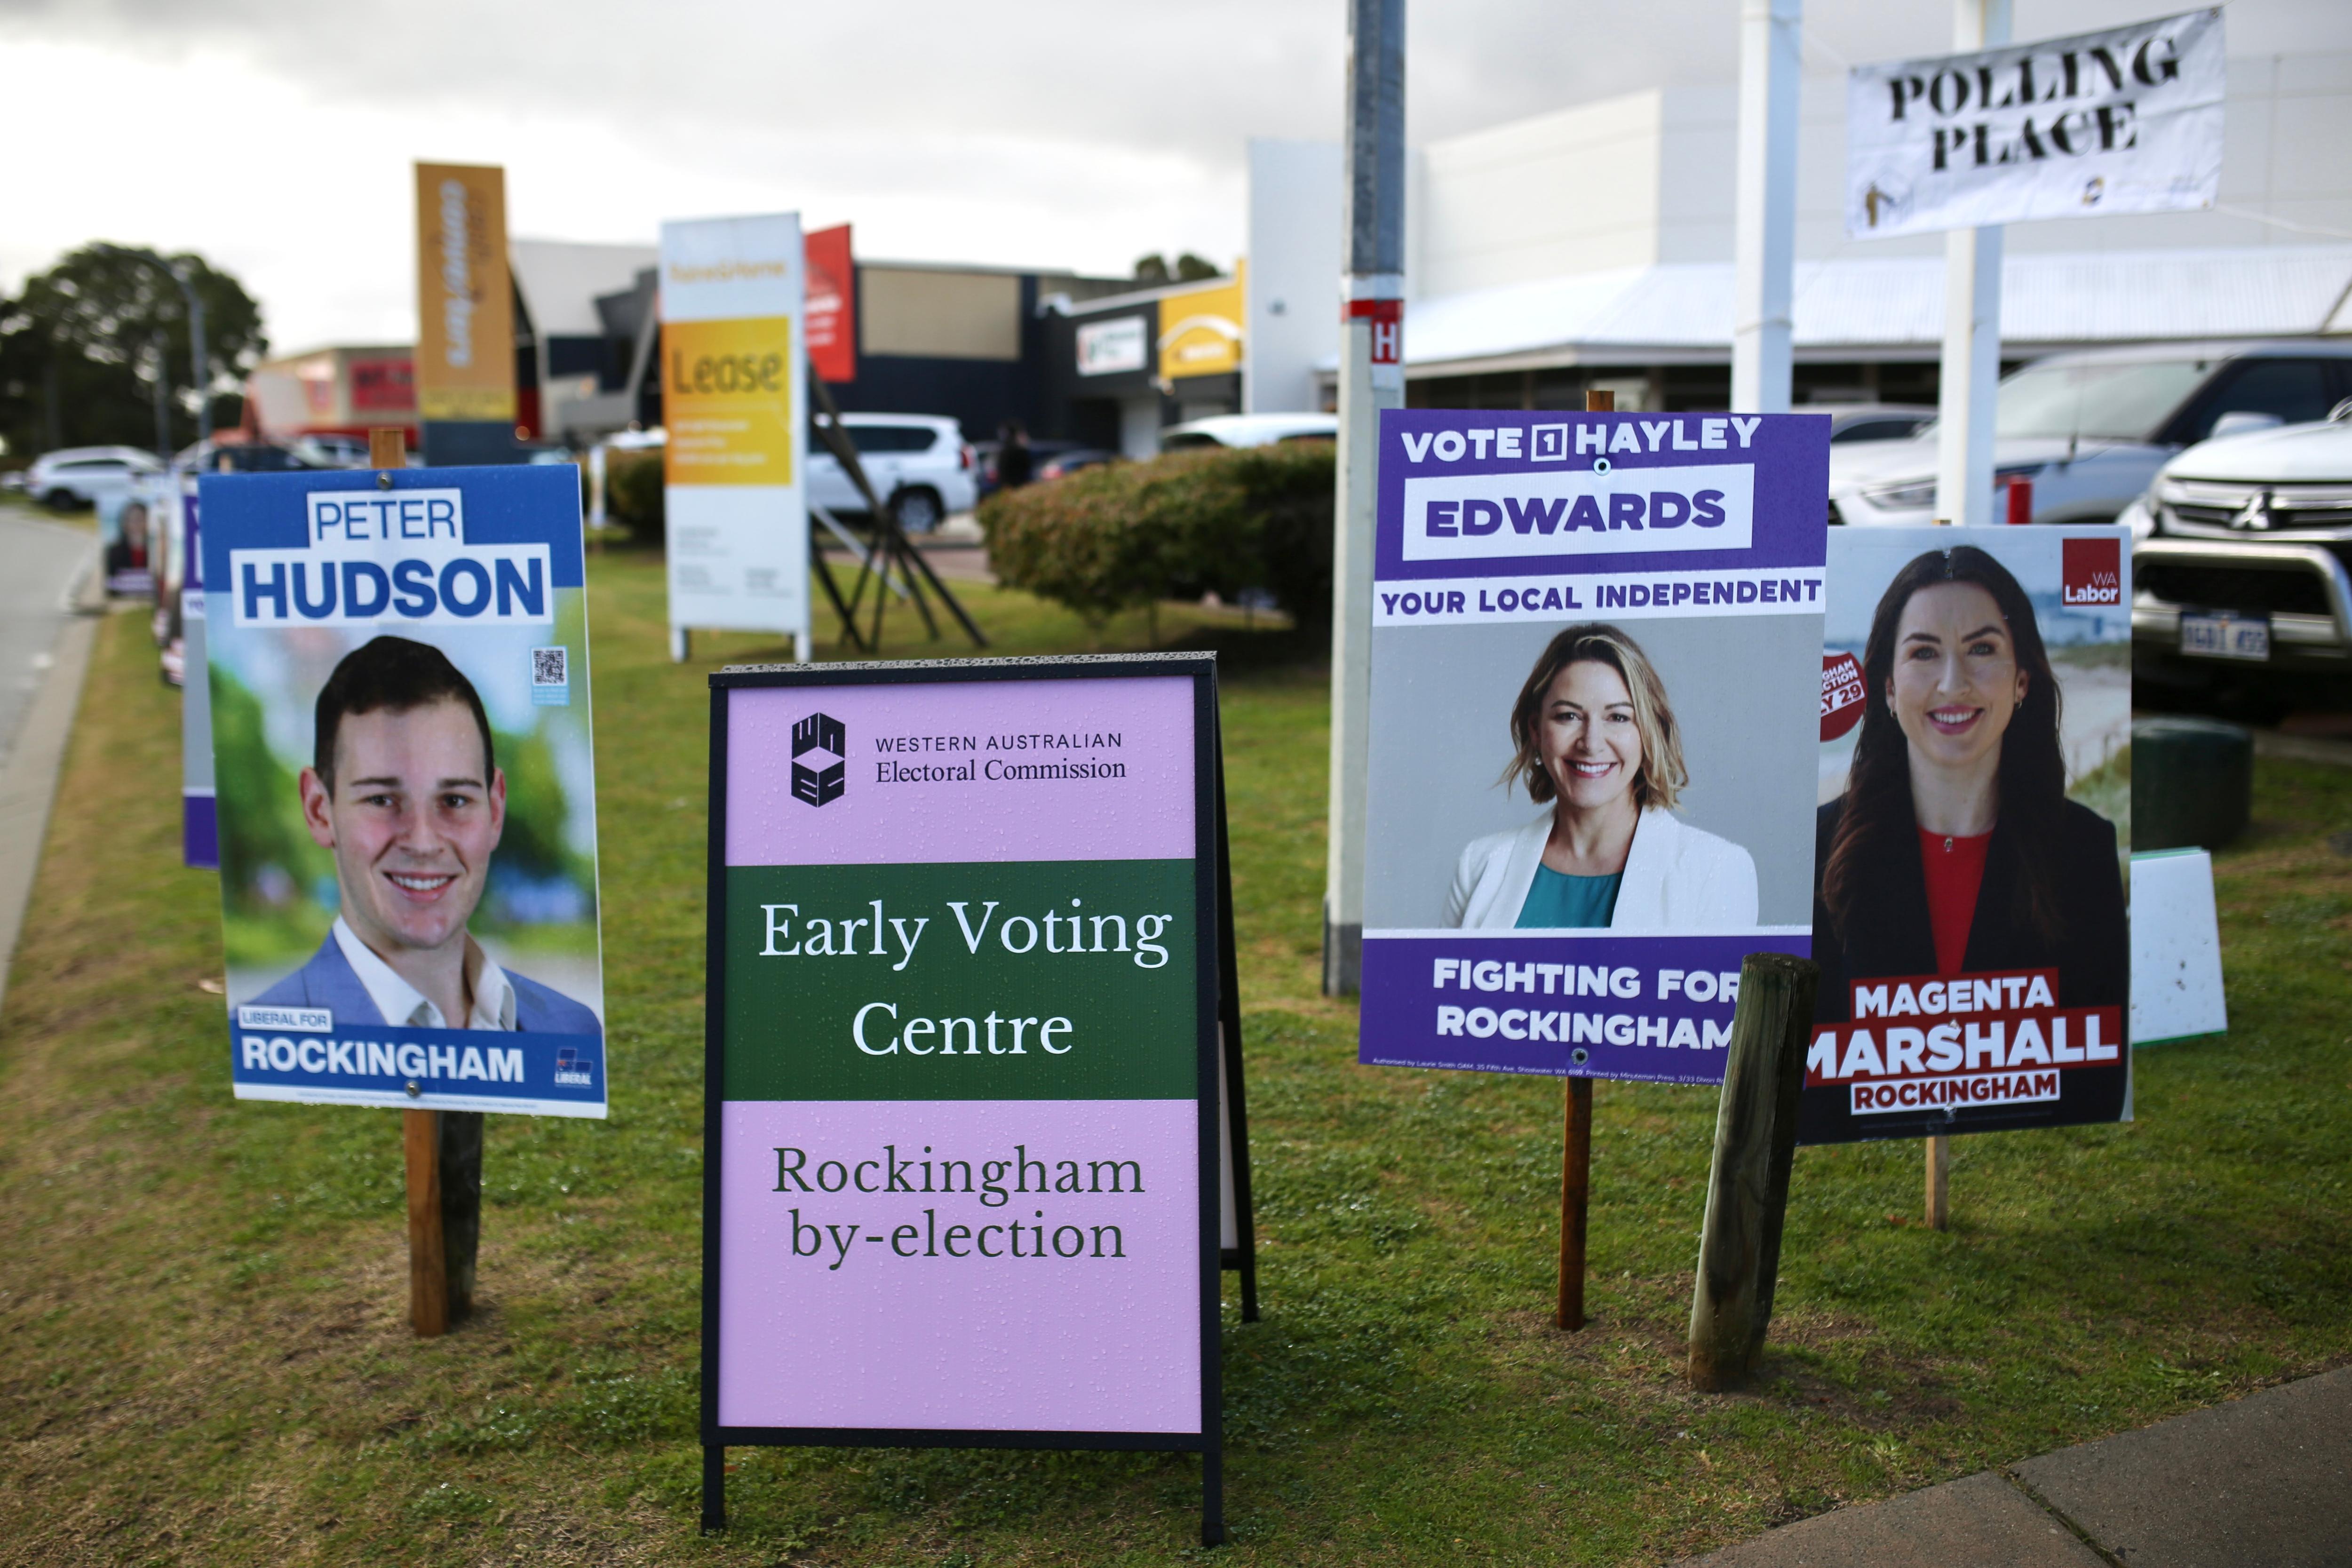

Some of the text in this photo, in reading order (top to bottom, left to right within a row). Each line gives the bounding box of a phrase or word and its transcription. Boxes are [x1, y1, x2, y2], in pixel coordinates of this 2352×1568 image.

[1887, 36, 2180, 121] POLLING
[1931, 102, 2137, 171] PLACE
[1375, 322, 1396, 359] H
[673, 349, 782, 394] Lease
[1401, 428, 1522, 462] VOTE
[1576, 417, 1761, 454] HAYLEY
[315, 499, 456, 541] PETER
[1426, 490, 1725, 537] EDWARDS
[242, 558, 544, 620] HUDSON
[1381, 580, 1822, 616] YOUR LOCAL INDEPENDENT
[2066, 583, 2118, 603] Labor
[2092, 572, 2117, 586] WA
[1839, 685, 1861, 704] 29
[876, 733, 1121, 752] WESTERN AUSTRALIAN
[876, 757, 1126, 782] Electoral Commission
[758, 899, 1172, 971] Early Voting
[1434, 958, 1741, 1003] FIGHTING FOR
[1855, 975, 2055, 1019] MAGENTA
[242, 1012, 327, 1027] LIBERAL FOR
[852, 1002, 1073, 1055] Centre
[1437, 1004, 1734, 1050] ROCKINGHAM
[242, 1036, 524, 1082] ROCKINGHAM
[1373, 1058, 1405, 1066] Authorised
[1620, 1072, 1656, 1081] Minuteman
[1807, 1015, 2118, 1079] MARSHALL
[1854, 1075, 2057, 1110] ROCKINGHAM
[772, 1145, 1144, 1206] Rockingham
[788, 1209, 1126, 1270] by-election
